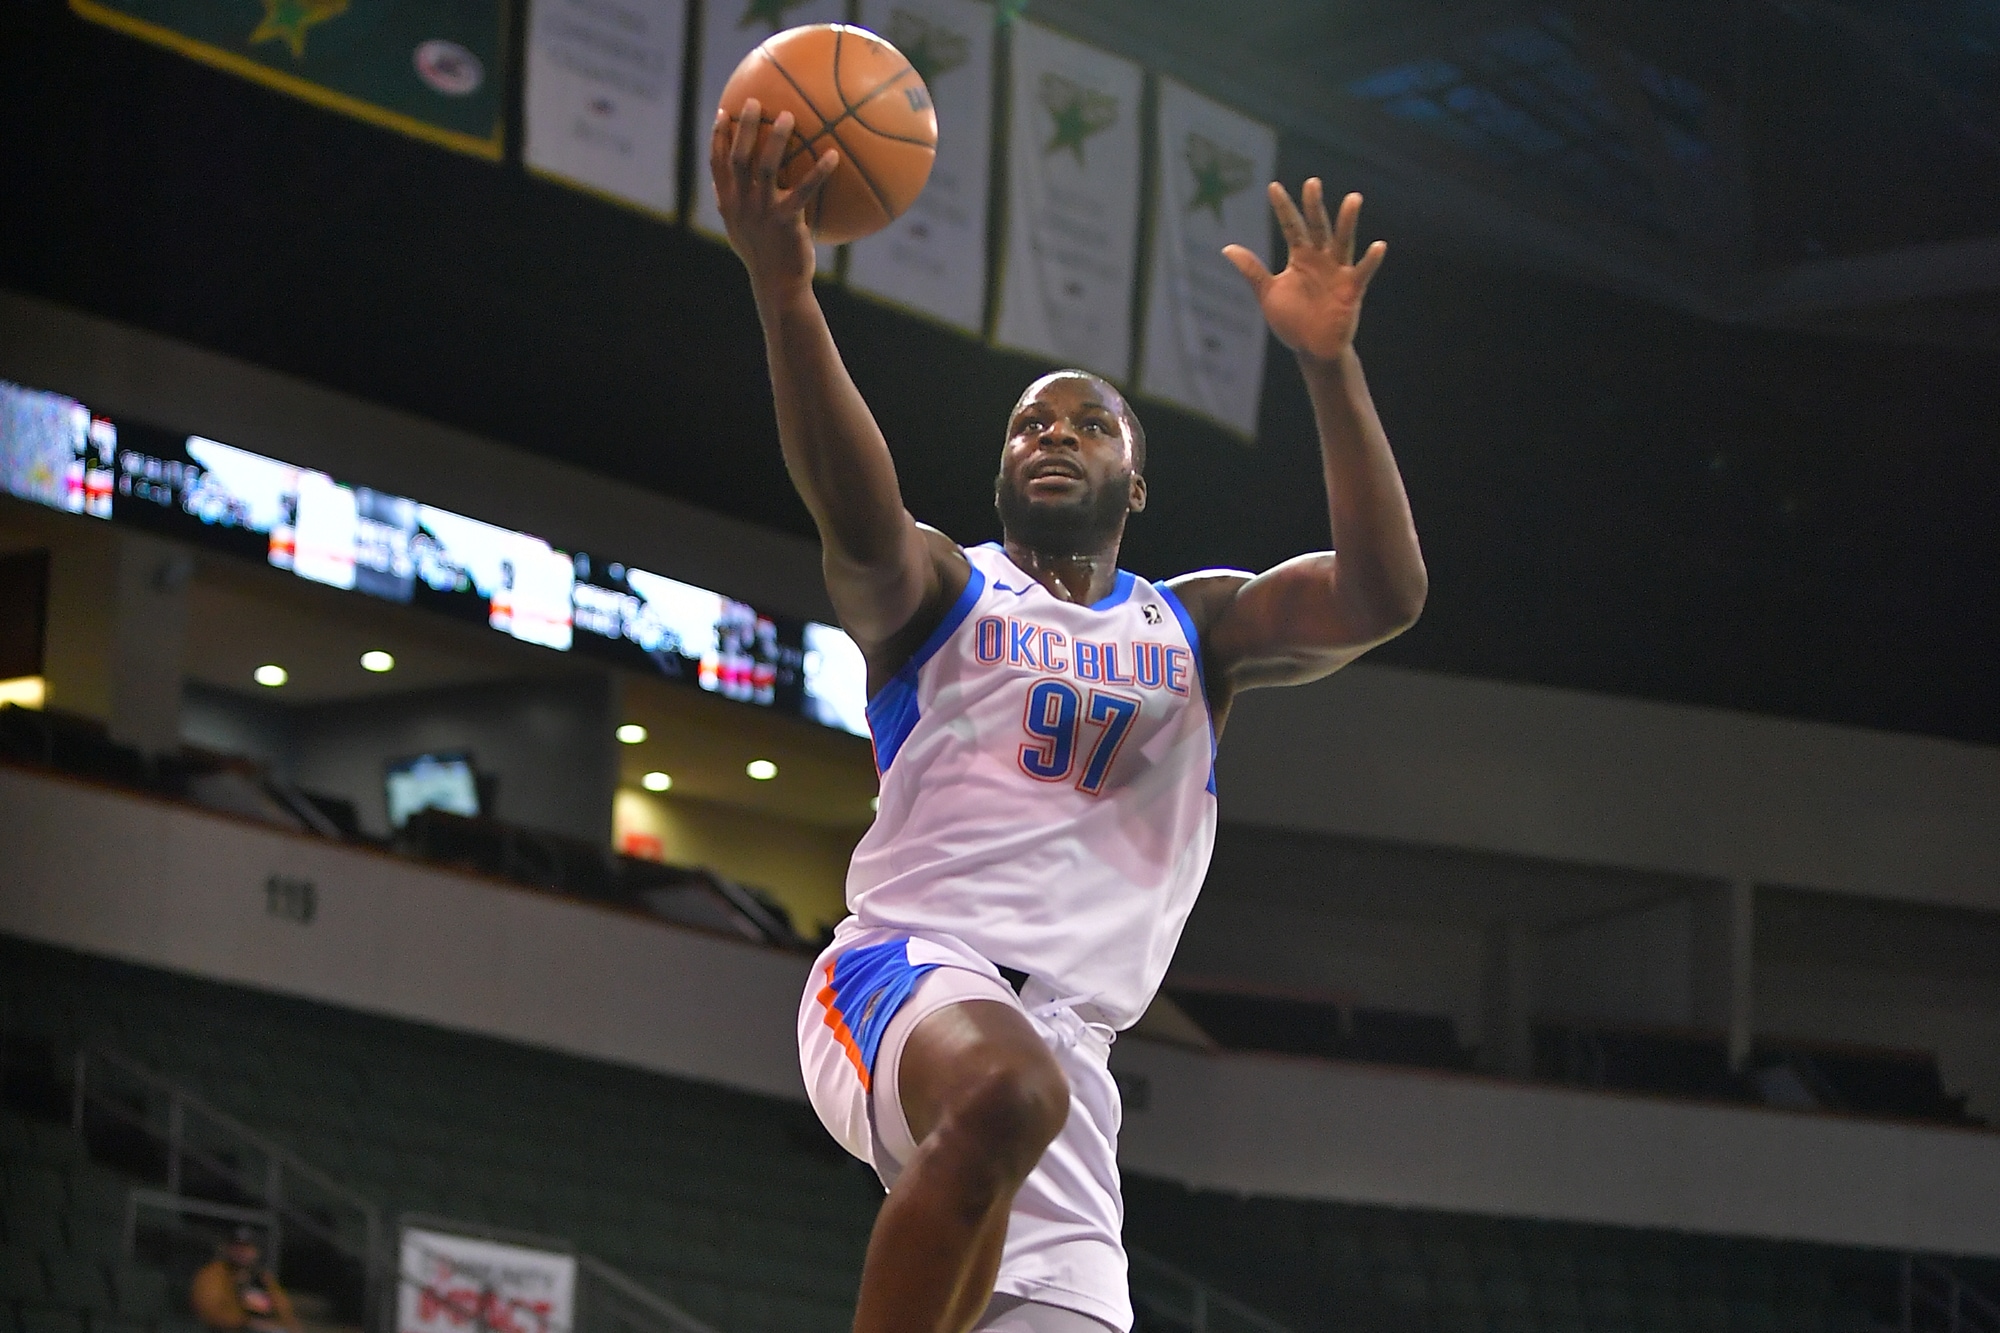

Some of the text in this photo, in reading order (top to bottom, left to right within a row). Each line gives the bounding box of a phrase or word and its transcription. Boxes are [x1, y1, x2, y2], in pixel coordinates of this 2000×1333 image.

[975, 615, 1190, 698] OKC BLUE
[1017, 677, 1142, 797] 97
